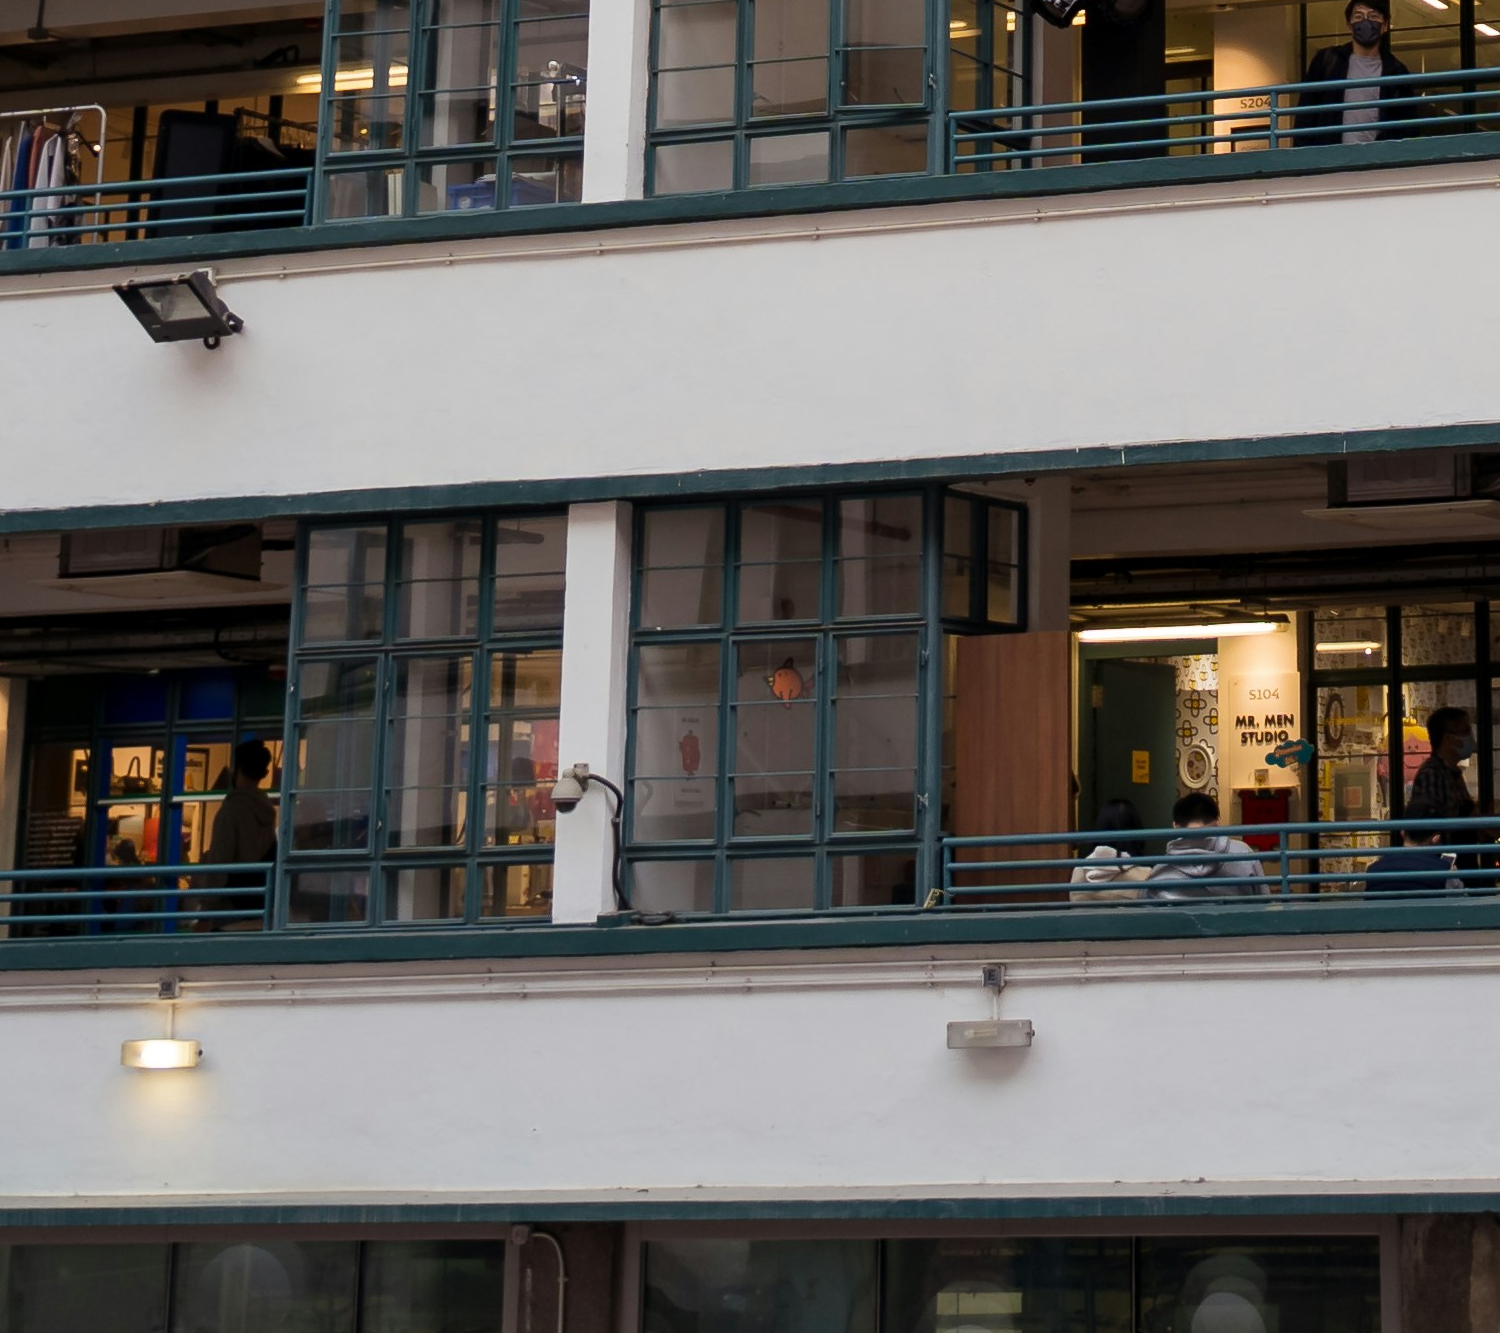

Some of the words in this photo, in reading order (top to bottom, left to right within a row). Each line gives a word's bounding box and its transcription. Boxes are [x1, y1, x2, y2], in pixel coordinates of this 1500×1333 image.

[1249, 688, 1280, 701] S104
[1235, 714, 1260, 730] MR.
[1264, 713, 1295, 729] MEN
[1241, 730, 1289, 746] STUDIO
